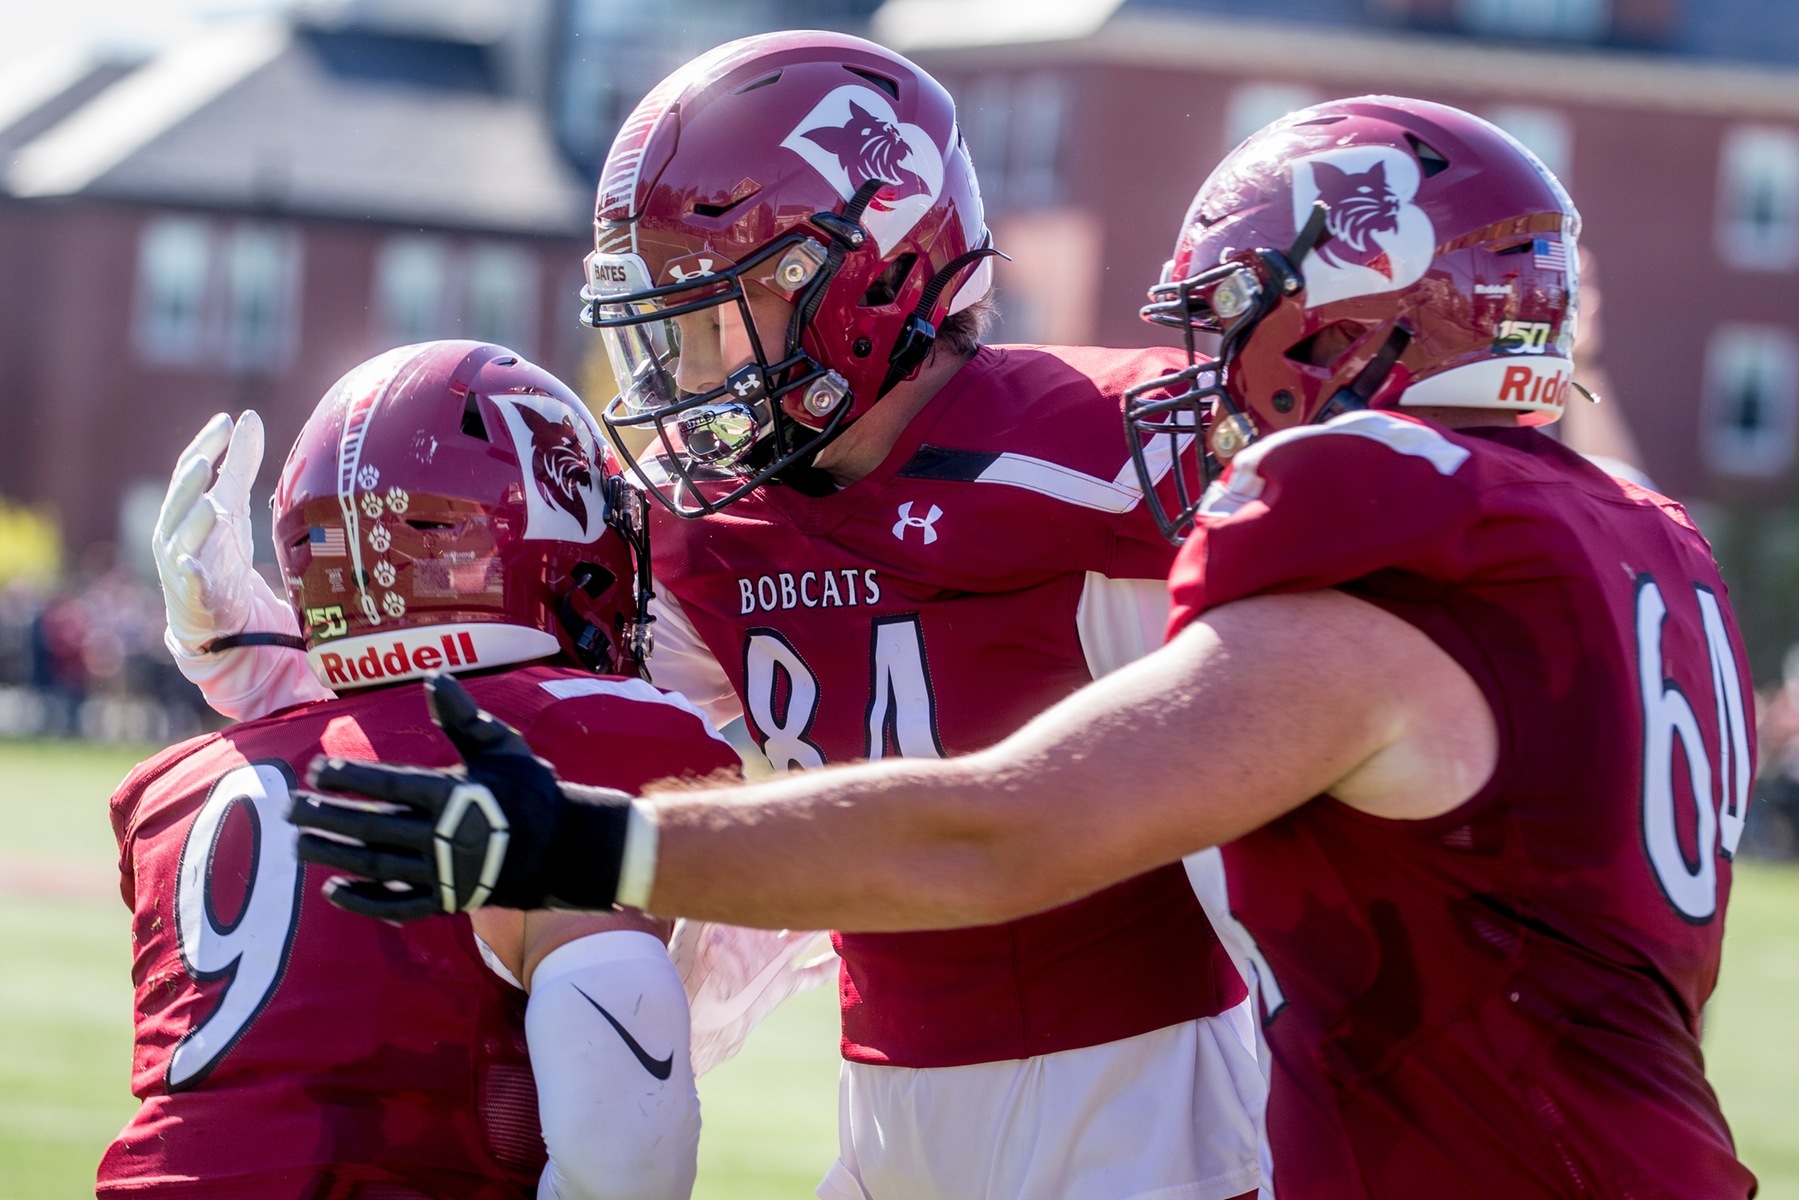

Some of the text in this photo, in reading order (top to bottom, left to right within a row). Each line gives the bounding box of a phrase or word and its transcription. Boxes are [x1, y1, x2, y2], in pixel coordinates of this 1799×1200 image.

[594, 263, 627, 282] BATES
[738, 569, 881, 615] BOBCATS
[306, 604, 348, 639] 150
[320, 631, 479, 685] Riddell
[742, 612, 950, 774] 84
[1635, 573, 1752, 926] 64
[163, 757, 307, 1095] 9
